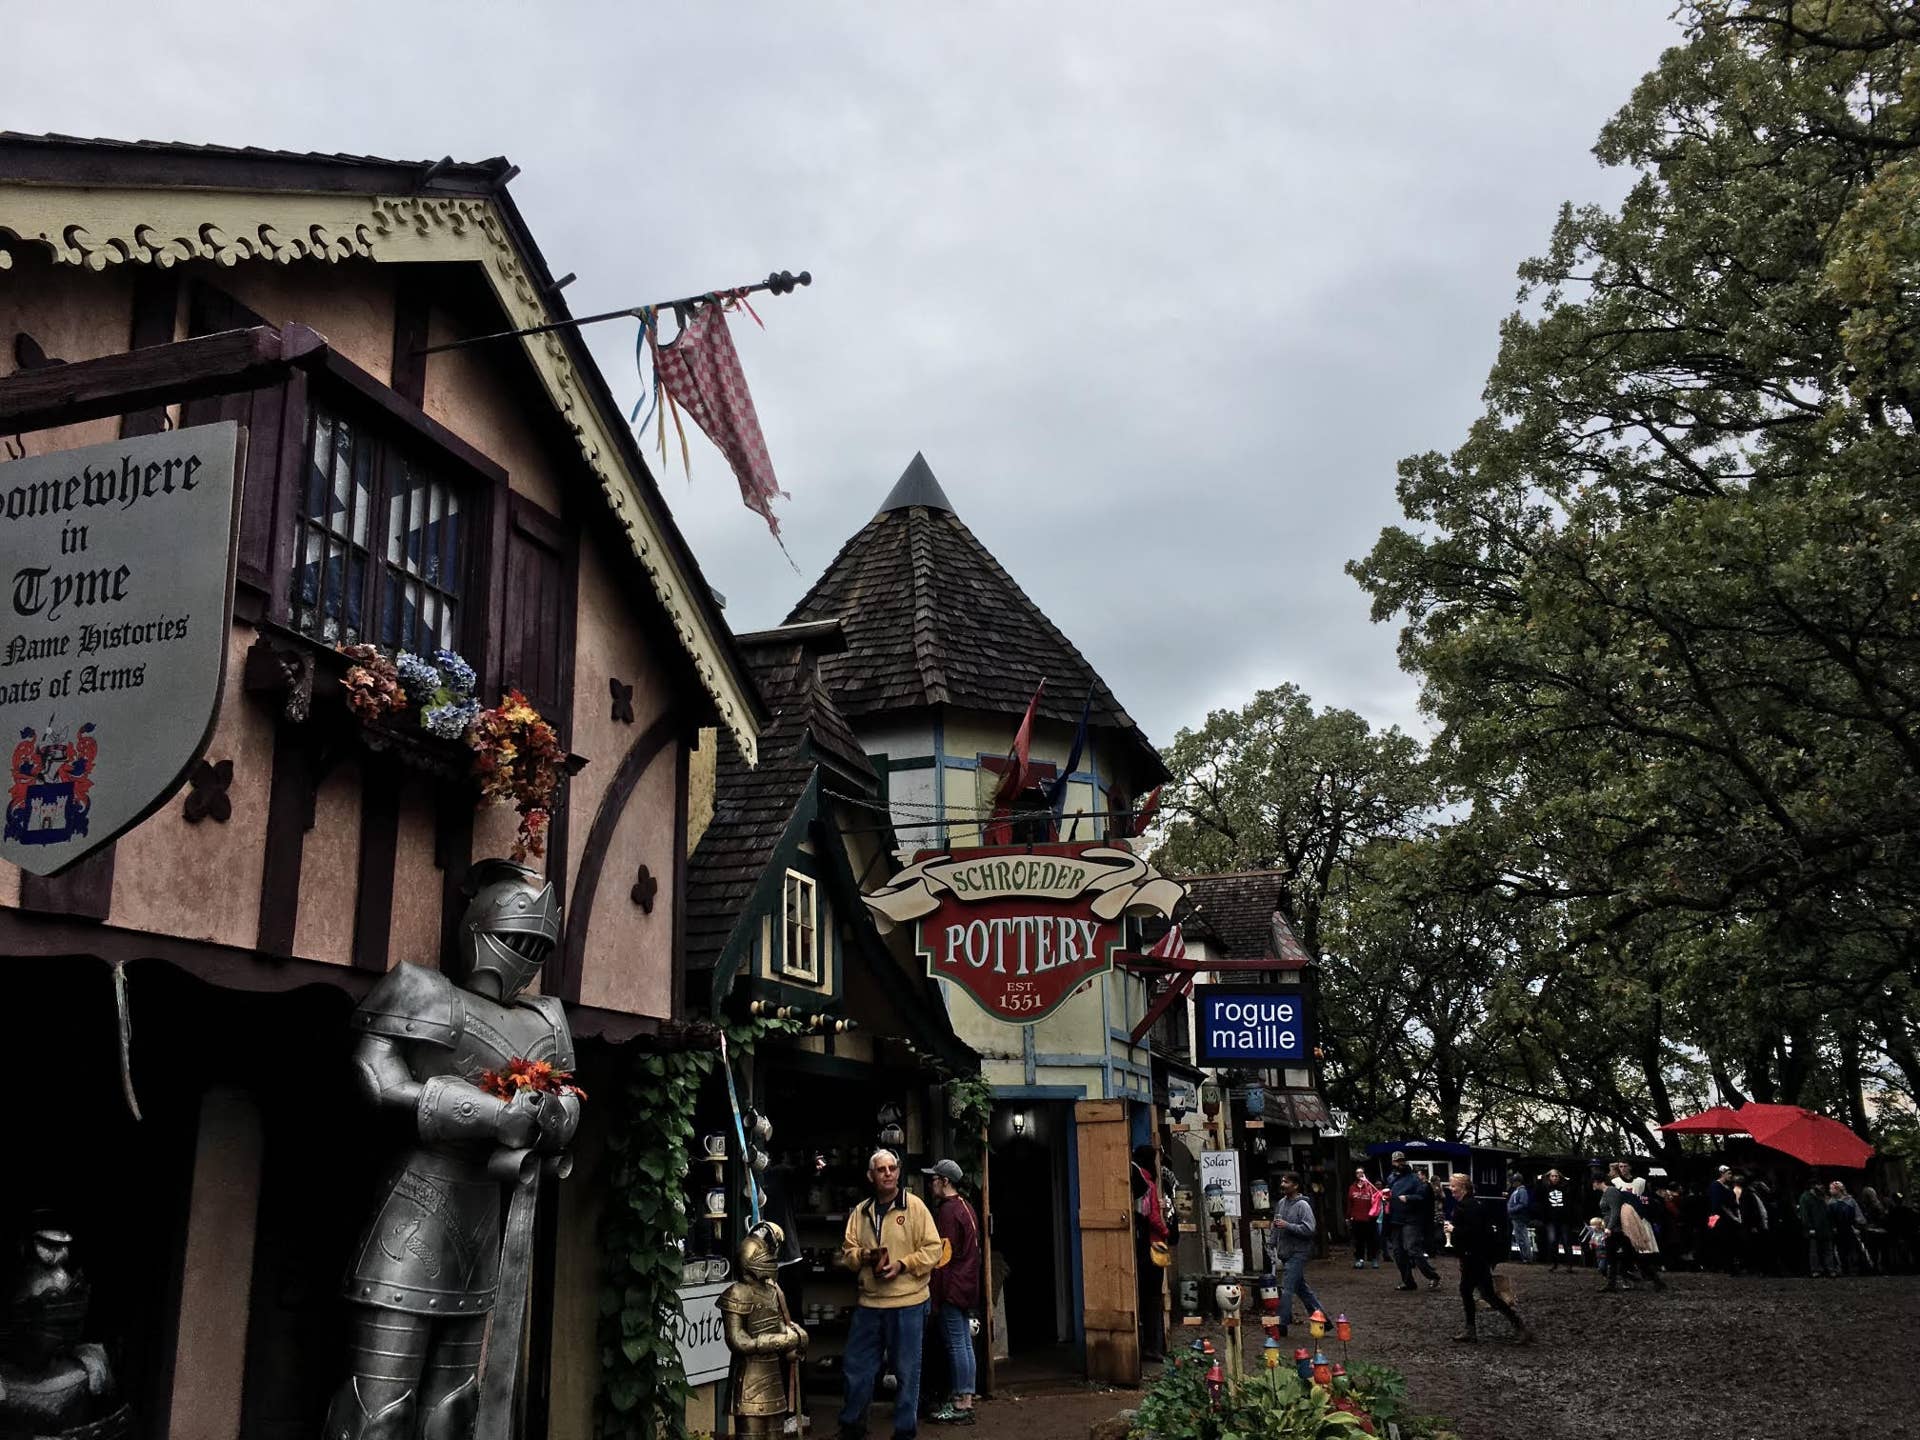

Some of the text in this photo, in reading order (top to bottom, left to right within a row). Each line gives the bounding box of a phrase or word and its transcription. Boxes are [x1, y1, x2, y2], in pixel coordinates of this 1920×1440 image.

[0, 454, 202, 520] omewhere
[61, 519, 89, 555] in
[12, 564, 131, 622] Tyme
[1, 614, 190, 667] Name Histories
[49, 670, 73, 698] of
[78, 663, 147, 696] Arms
[952, 860, 1086, 892] SCHROEDER
[945, 916, 1102, 975] POTTERY
[1000, 994, 1044, 1011] 1551
[1007, 982, 1037, 992] EST.
[1214, 1002, 1294, 1028] rogue
[1212, 1025, 1296, 1049] maille
[1203, 1153, 1232, 1168] Solar
